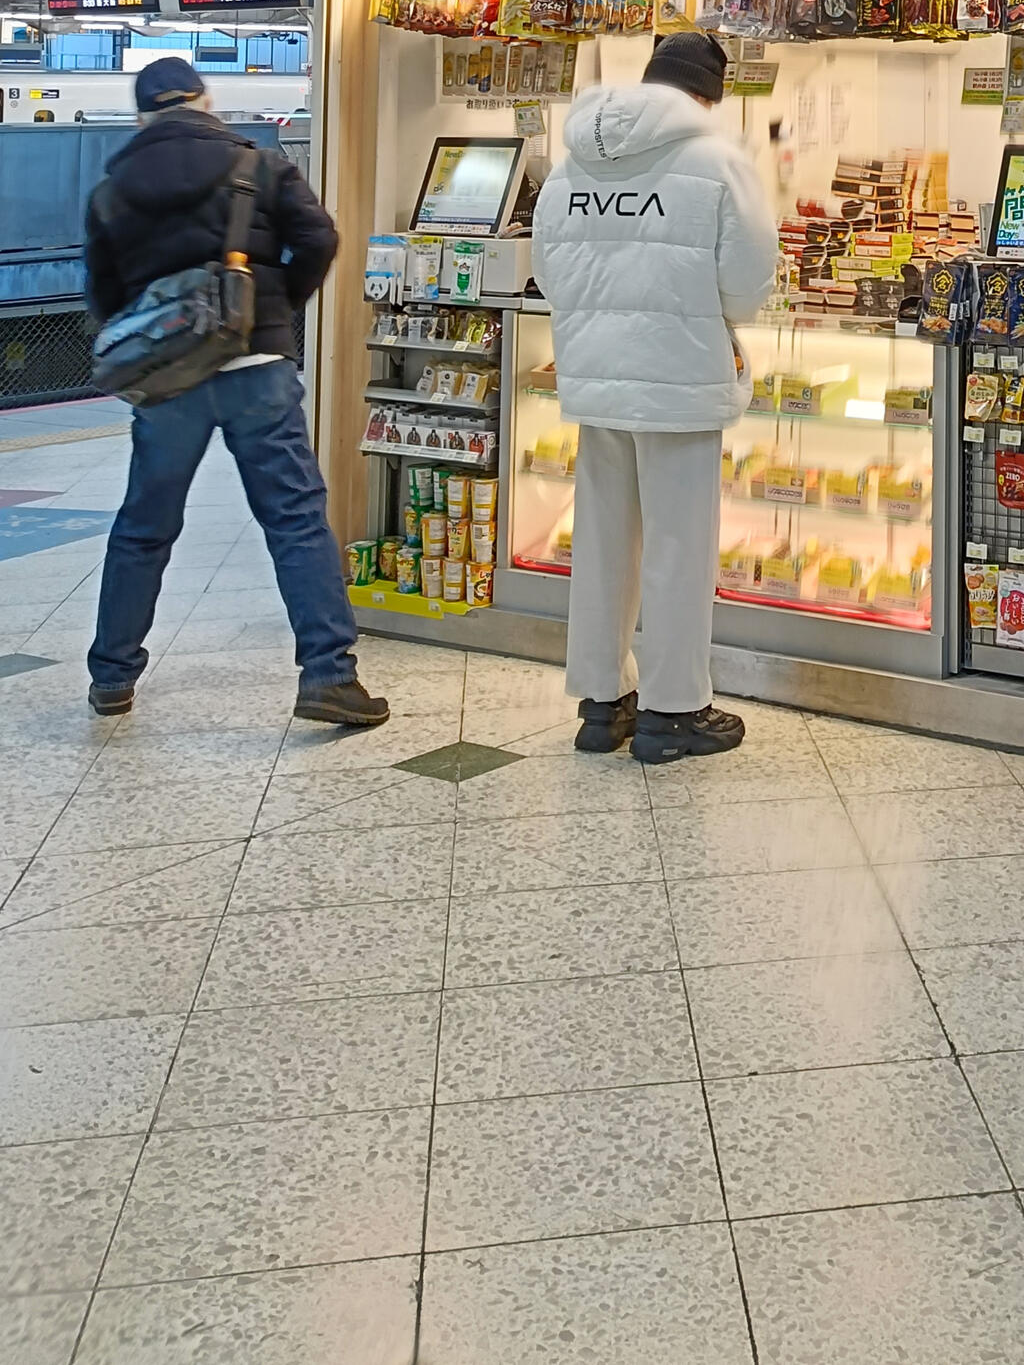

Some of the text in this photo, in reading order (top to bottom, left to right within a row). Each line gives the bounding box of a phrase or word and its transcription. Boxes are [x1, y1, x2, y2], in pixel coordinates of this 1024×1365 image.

[11, 89, 18, 98] 3
[568, 192, 665, 217] RVCA
[1000, 221, 1020, 231] New
[998, 229, 1020, 240] Days
[1005, 471, 1021, 482] ZERO
